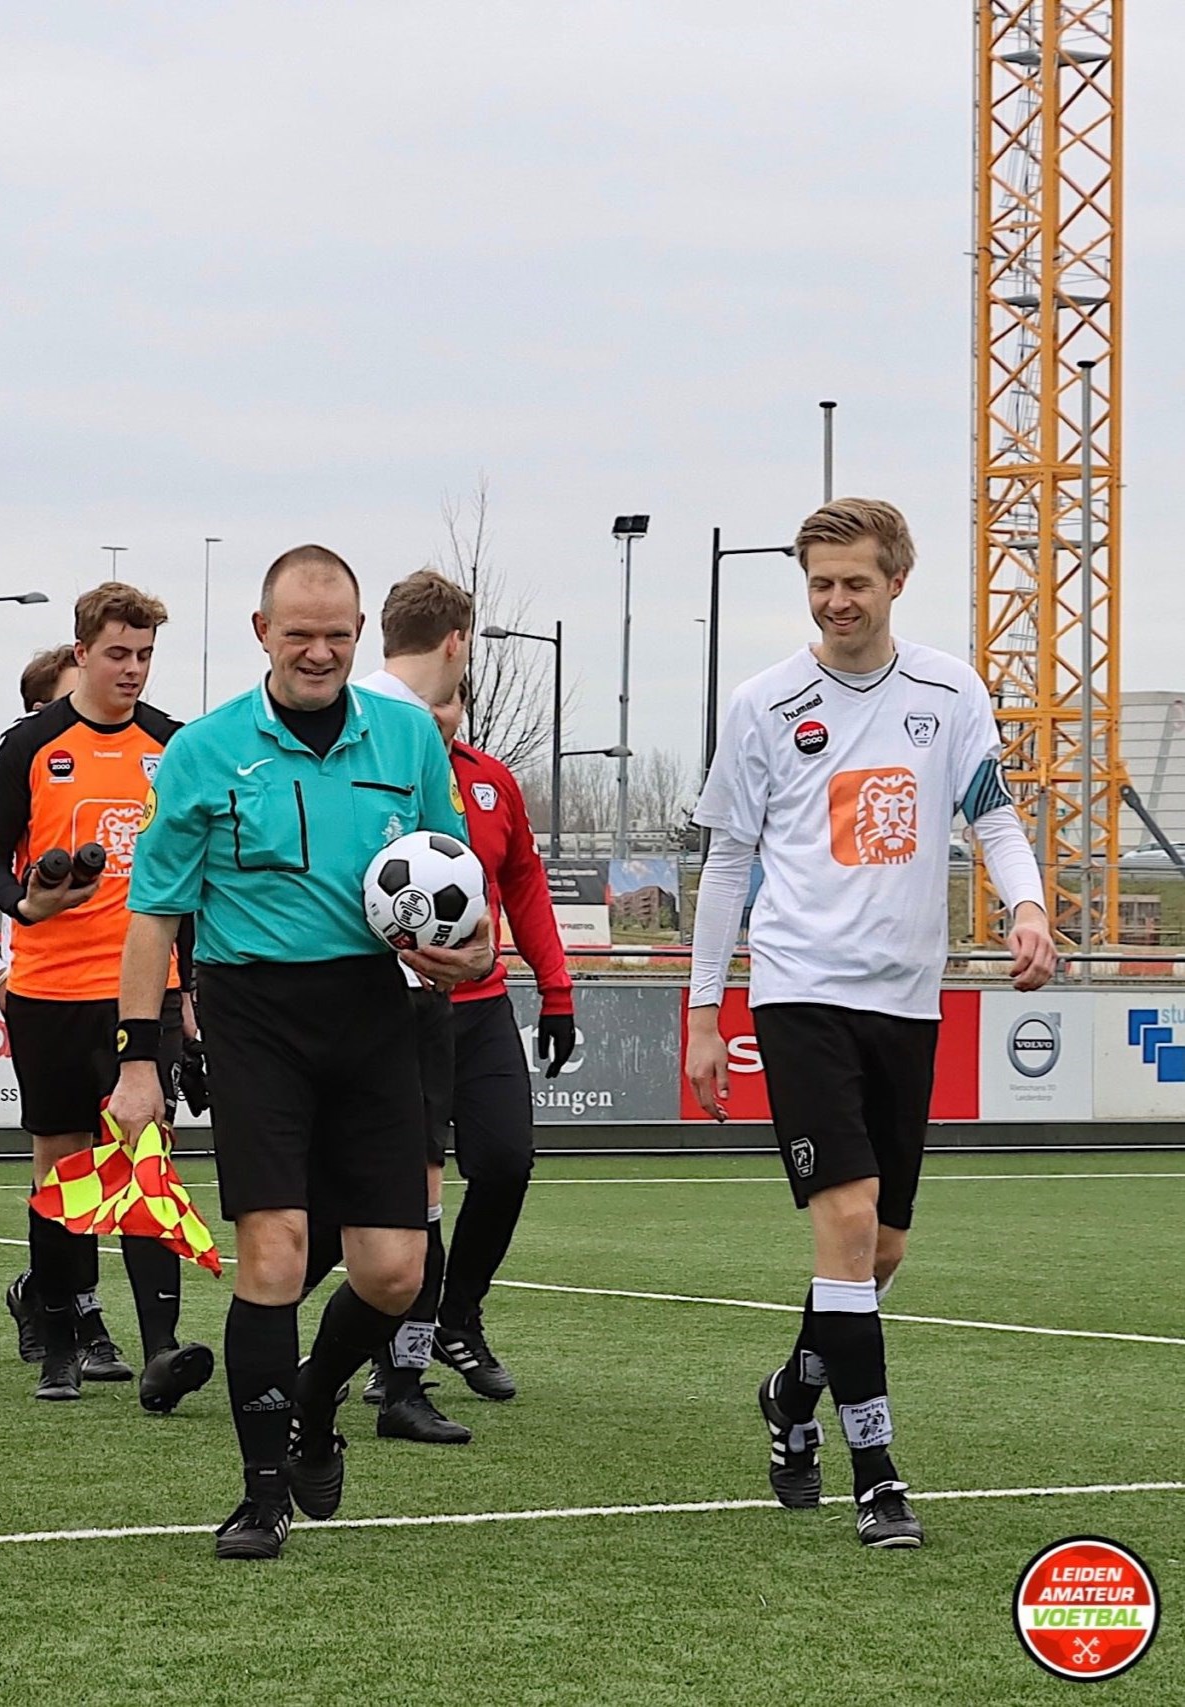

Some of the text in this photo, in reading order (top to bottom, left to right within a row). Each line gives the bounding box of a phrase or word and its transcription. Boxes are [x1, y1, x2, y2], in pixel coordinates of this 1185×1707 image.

[782, 693, 824, 721] hummel
[796, 727, 824, 740] SPORT
[800, 736, 824, 746] 2000
[1015, 1040, 1053, 1049] VOLVO
[242, 1400, 292, 1411] adidas
